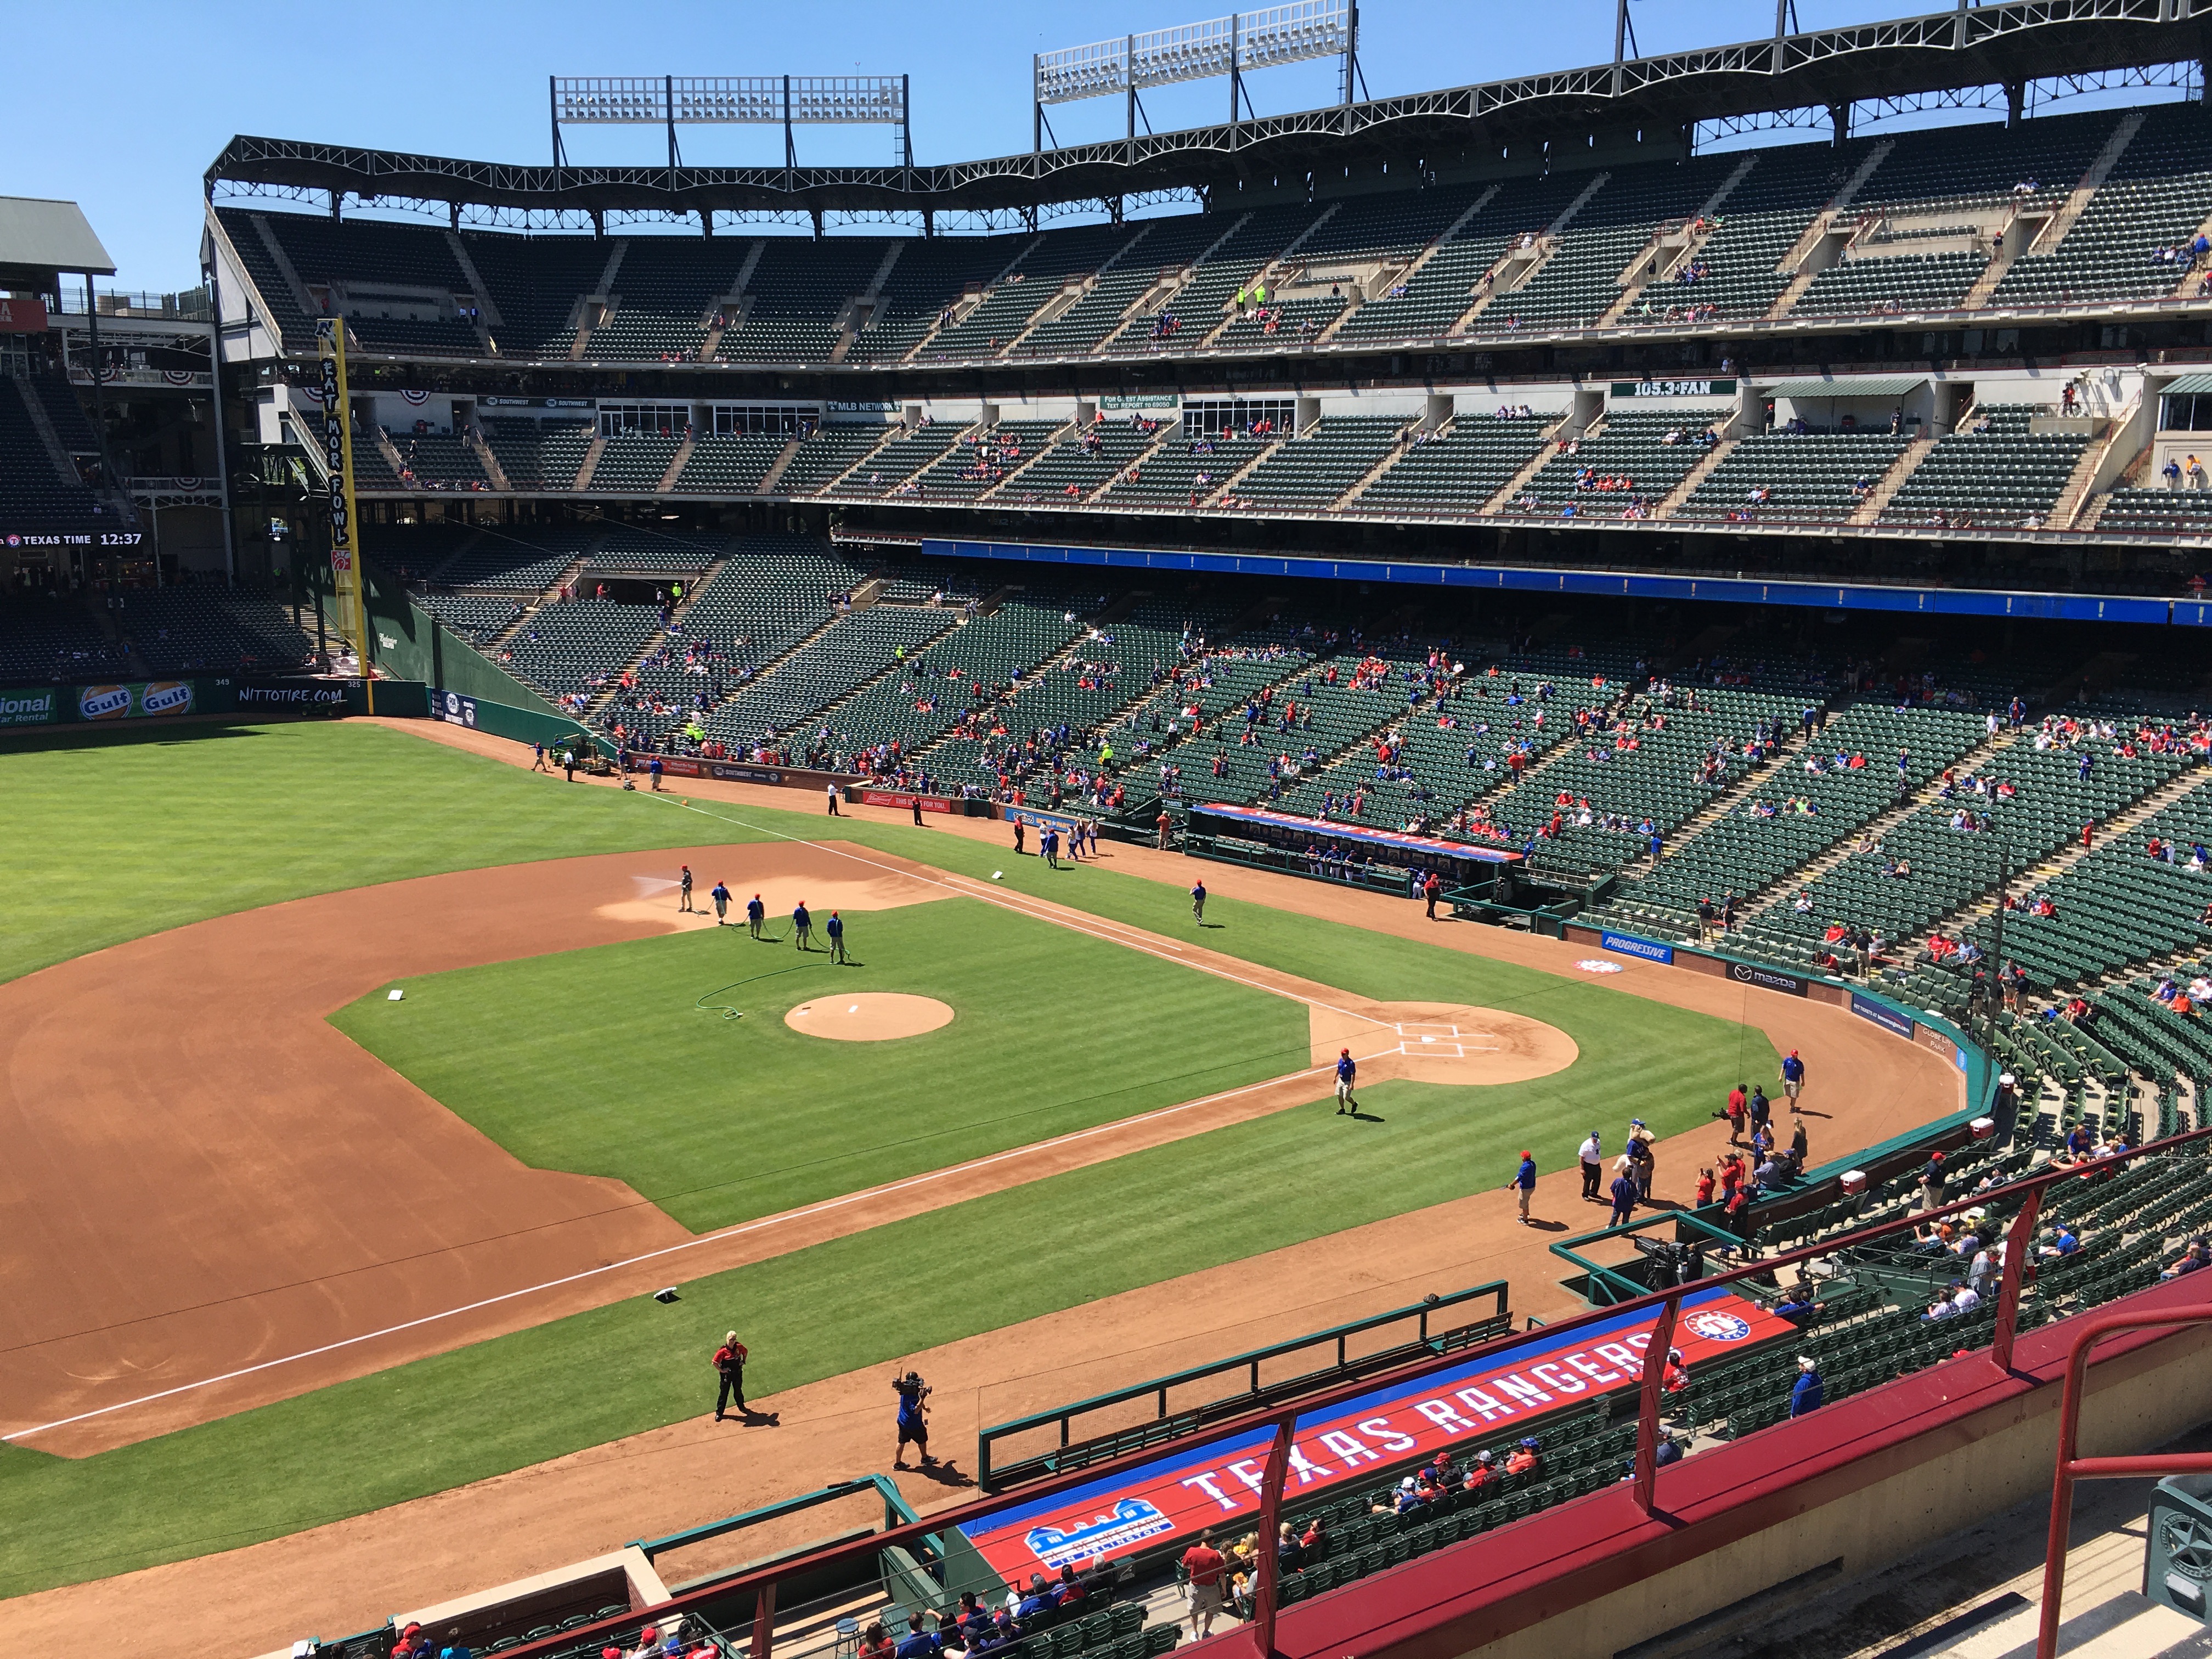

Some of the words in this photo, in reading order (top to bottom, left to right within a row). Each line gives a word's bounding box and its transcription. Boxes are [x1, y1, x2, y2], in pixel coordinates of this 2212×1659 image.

[324, 362, 335, 410] EAT
[1635, 382, 1674, 396] 105.3
[1679, 381, 1711, 395] FAN
[838, 402, 857, 410] MLB
[859, 401, 893, 410] NETWORK
[329, 420, 340, 469] MOR
[332, 478, 345, 542] FOWL
[23, 536, 60, 545] TEXAS
[64, 535, 91, 544] TIME
[101, 534, 142, 545] 12:37
[84, 691, 127, 714] Gulf
[145, 688, 188, 710] Gulf
[239, 686, 342, 702] NITTOTIRE.COM
[15, 713, 48, 722] Rental
[1605, 936, 1666, 958] PROGRESSIVE
[1754, 972, 1796, 989] mazda
[1922, 1028, 1941, 1041] GLOBE
[1930, 1041, 1945, 1053] PARK
[1182, 1417, 1415, 1510] TEXAS
[1096, 1527, 1126, 1544] LIFE
[1128, 1515, 1167, 1533] PARK
[1060, 1555, 1078, 1564] IN
[1083, 1526, 1163, 1556] ARLINGTON
